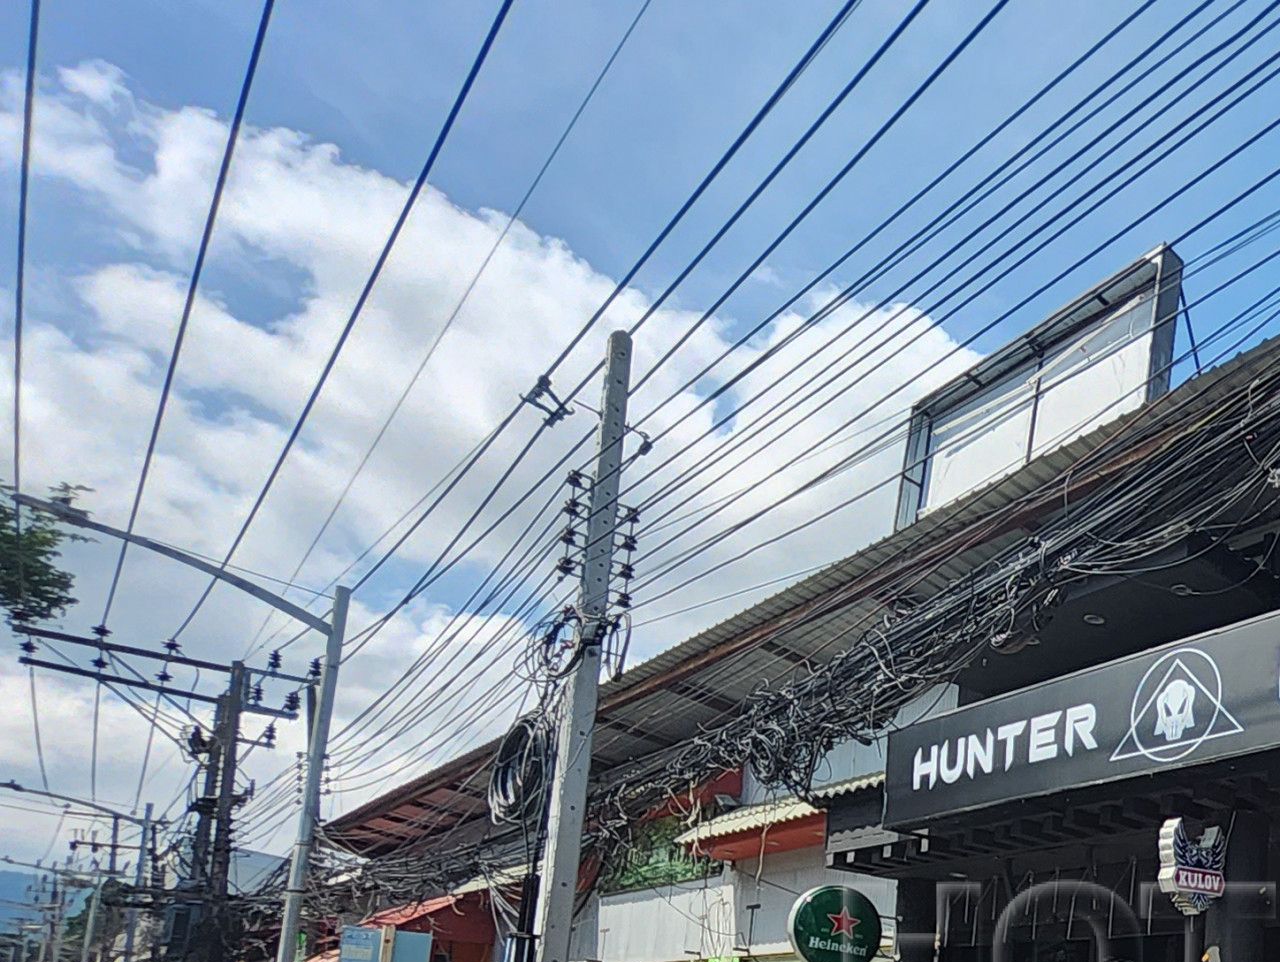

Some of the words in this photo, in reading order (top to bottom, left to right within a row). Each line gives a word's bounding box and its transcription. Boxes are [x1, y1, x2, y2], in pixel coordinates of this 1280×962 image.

[912, 703, 1099, 791] HUNTER
[1178, 870, 1221, 891] KULOV
[808, 936, 868, 957] Heineken
